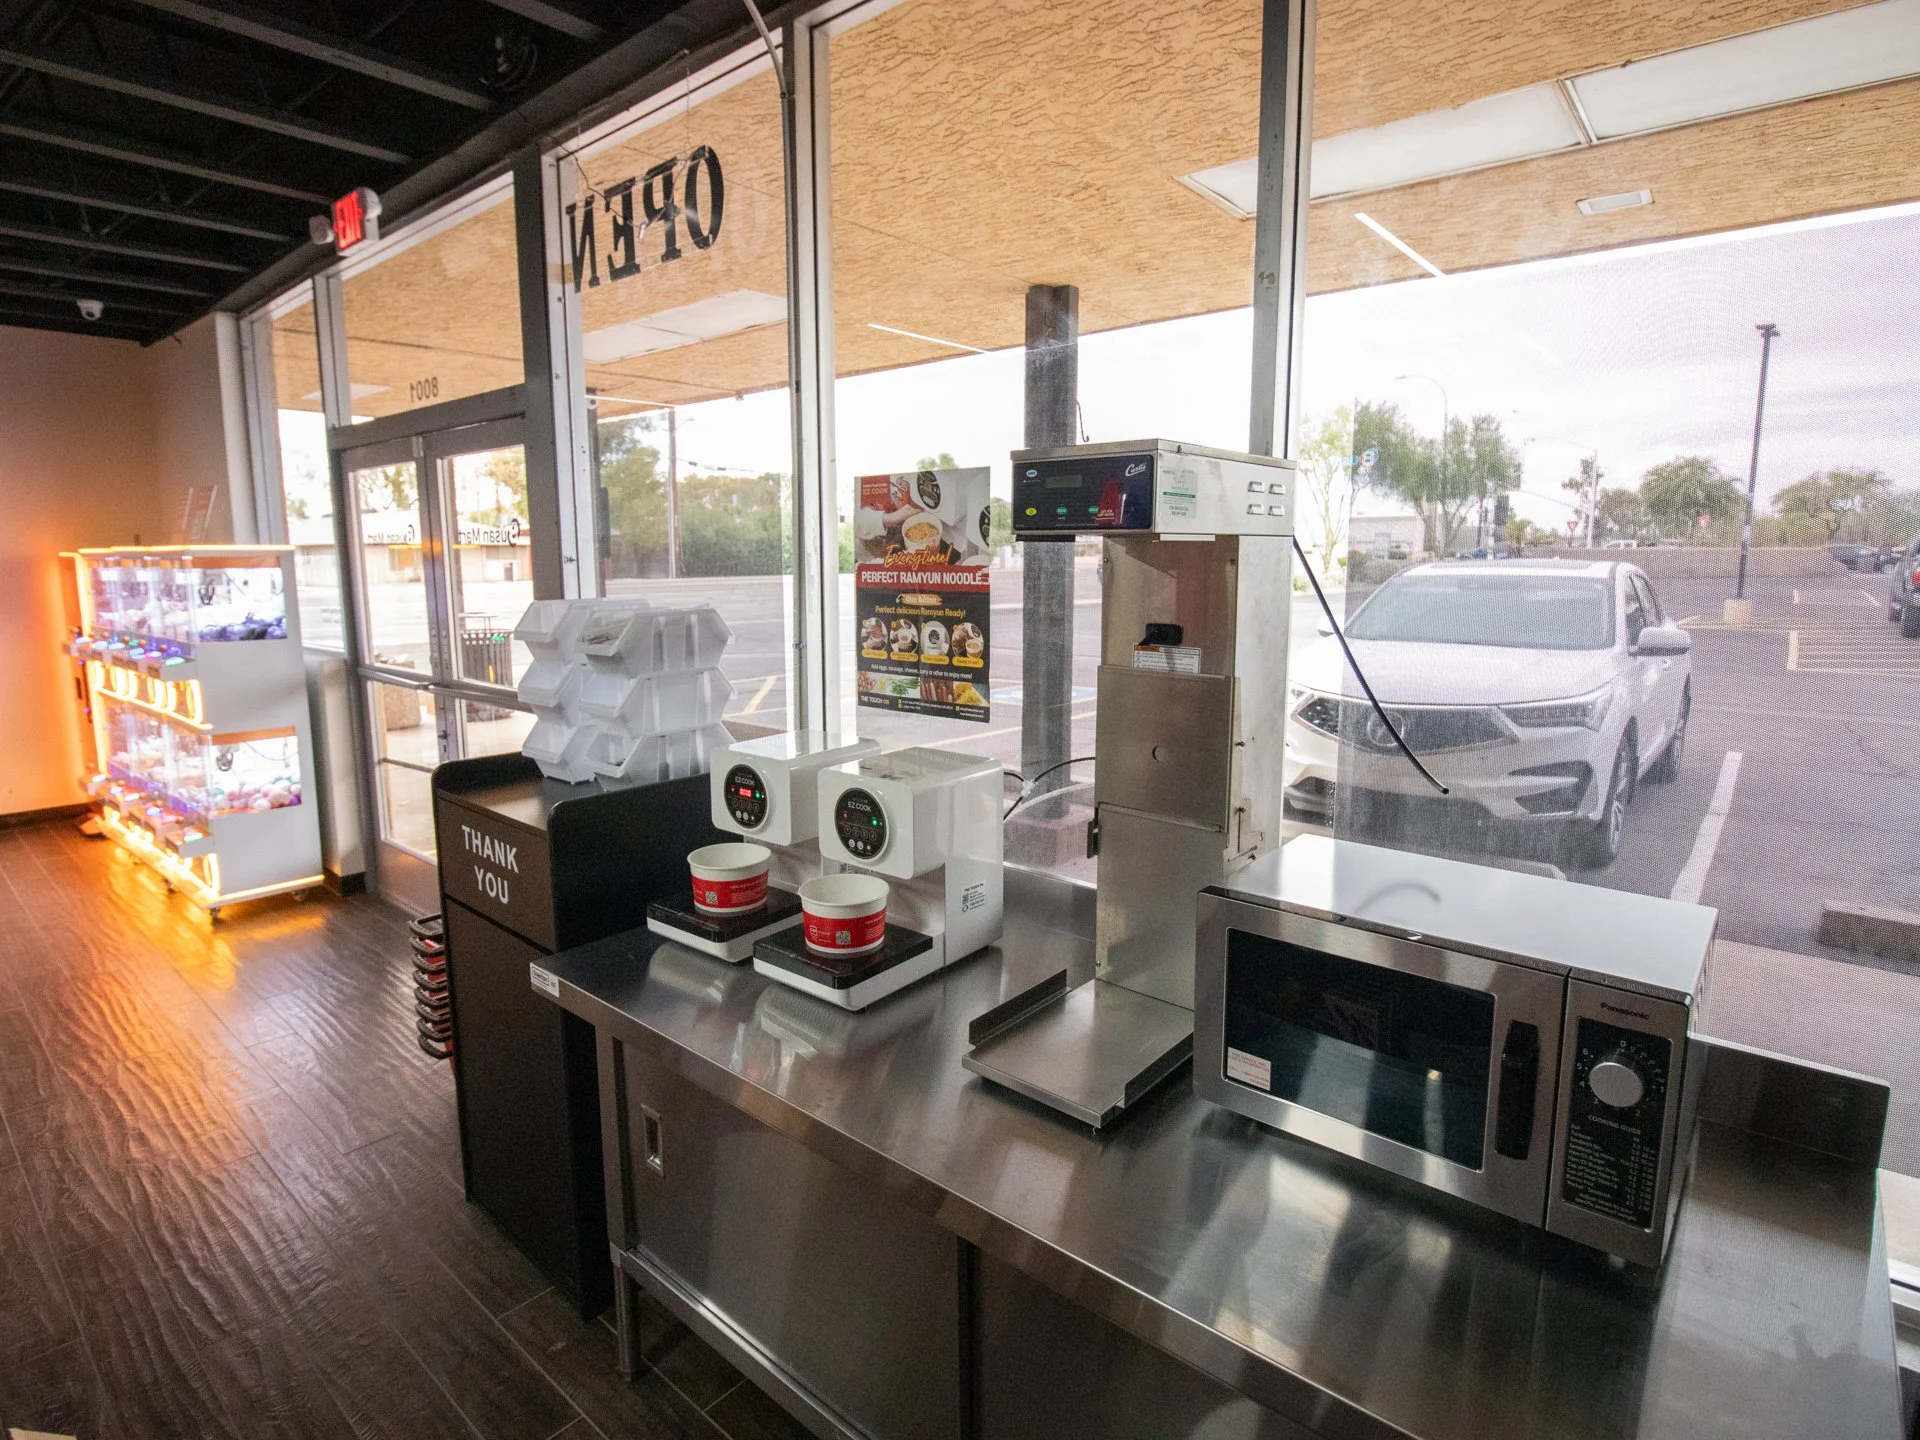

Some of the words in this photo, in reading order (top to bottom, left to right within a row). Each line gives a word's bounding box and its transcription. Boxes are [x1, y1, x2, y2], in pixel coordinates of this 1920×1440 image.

[1125, 462, 1147, 477] Curtis
[862, 487, 871, 495] EZ
[872, 487, 889, 495] COOK
[883, 543, 954, 570] Everytime!
[861, 571, 898, 583] PERFECT
[900, 571, 942, 584] RAMYUN
[875, 605, 895, 614] Perfect
[896, 606, 920, 615] delicious
[920, 607, 944, 618] Ramyun
[945, 609, 966, 619] Ready!
[847, 801, 855, 809] EZ
[855, 803, 872, 812] COOK
[461, 824, 519, 874] THANK
[474, 864, 509, 904] YOU
[1600, 1002, 1650, 1020] Panasonic
[1588, 1114, 1619, 1129] COOKING
[1620, 1124, 1641, 1135] GUIDE
